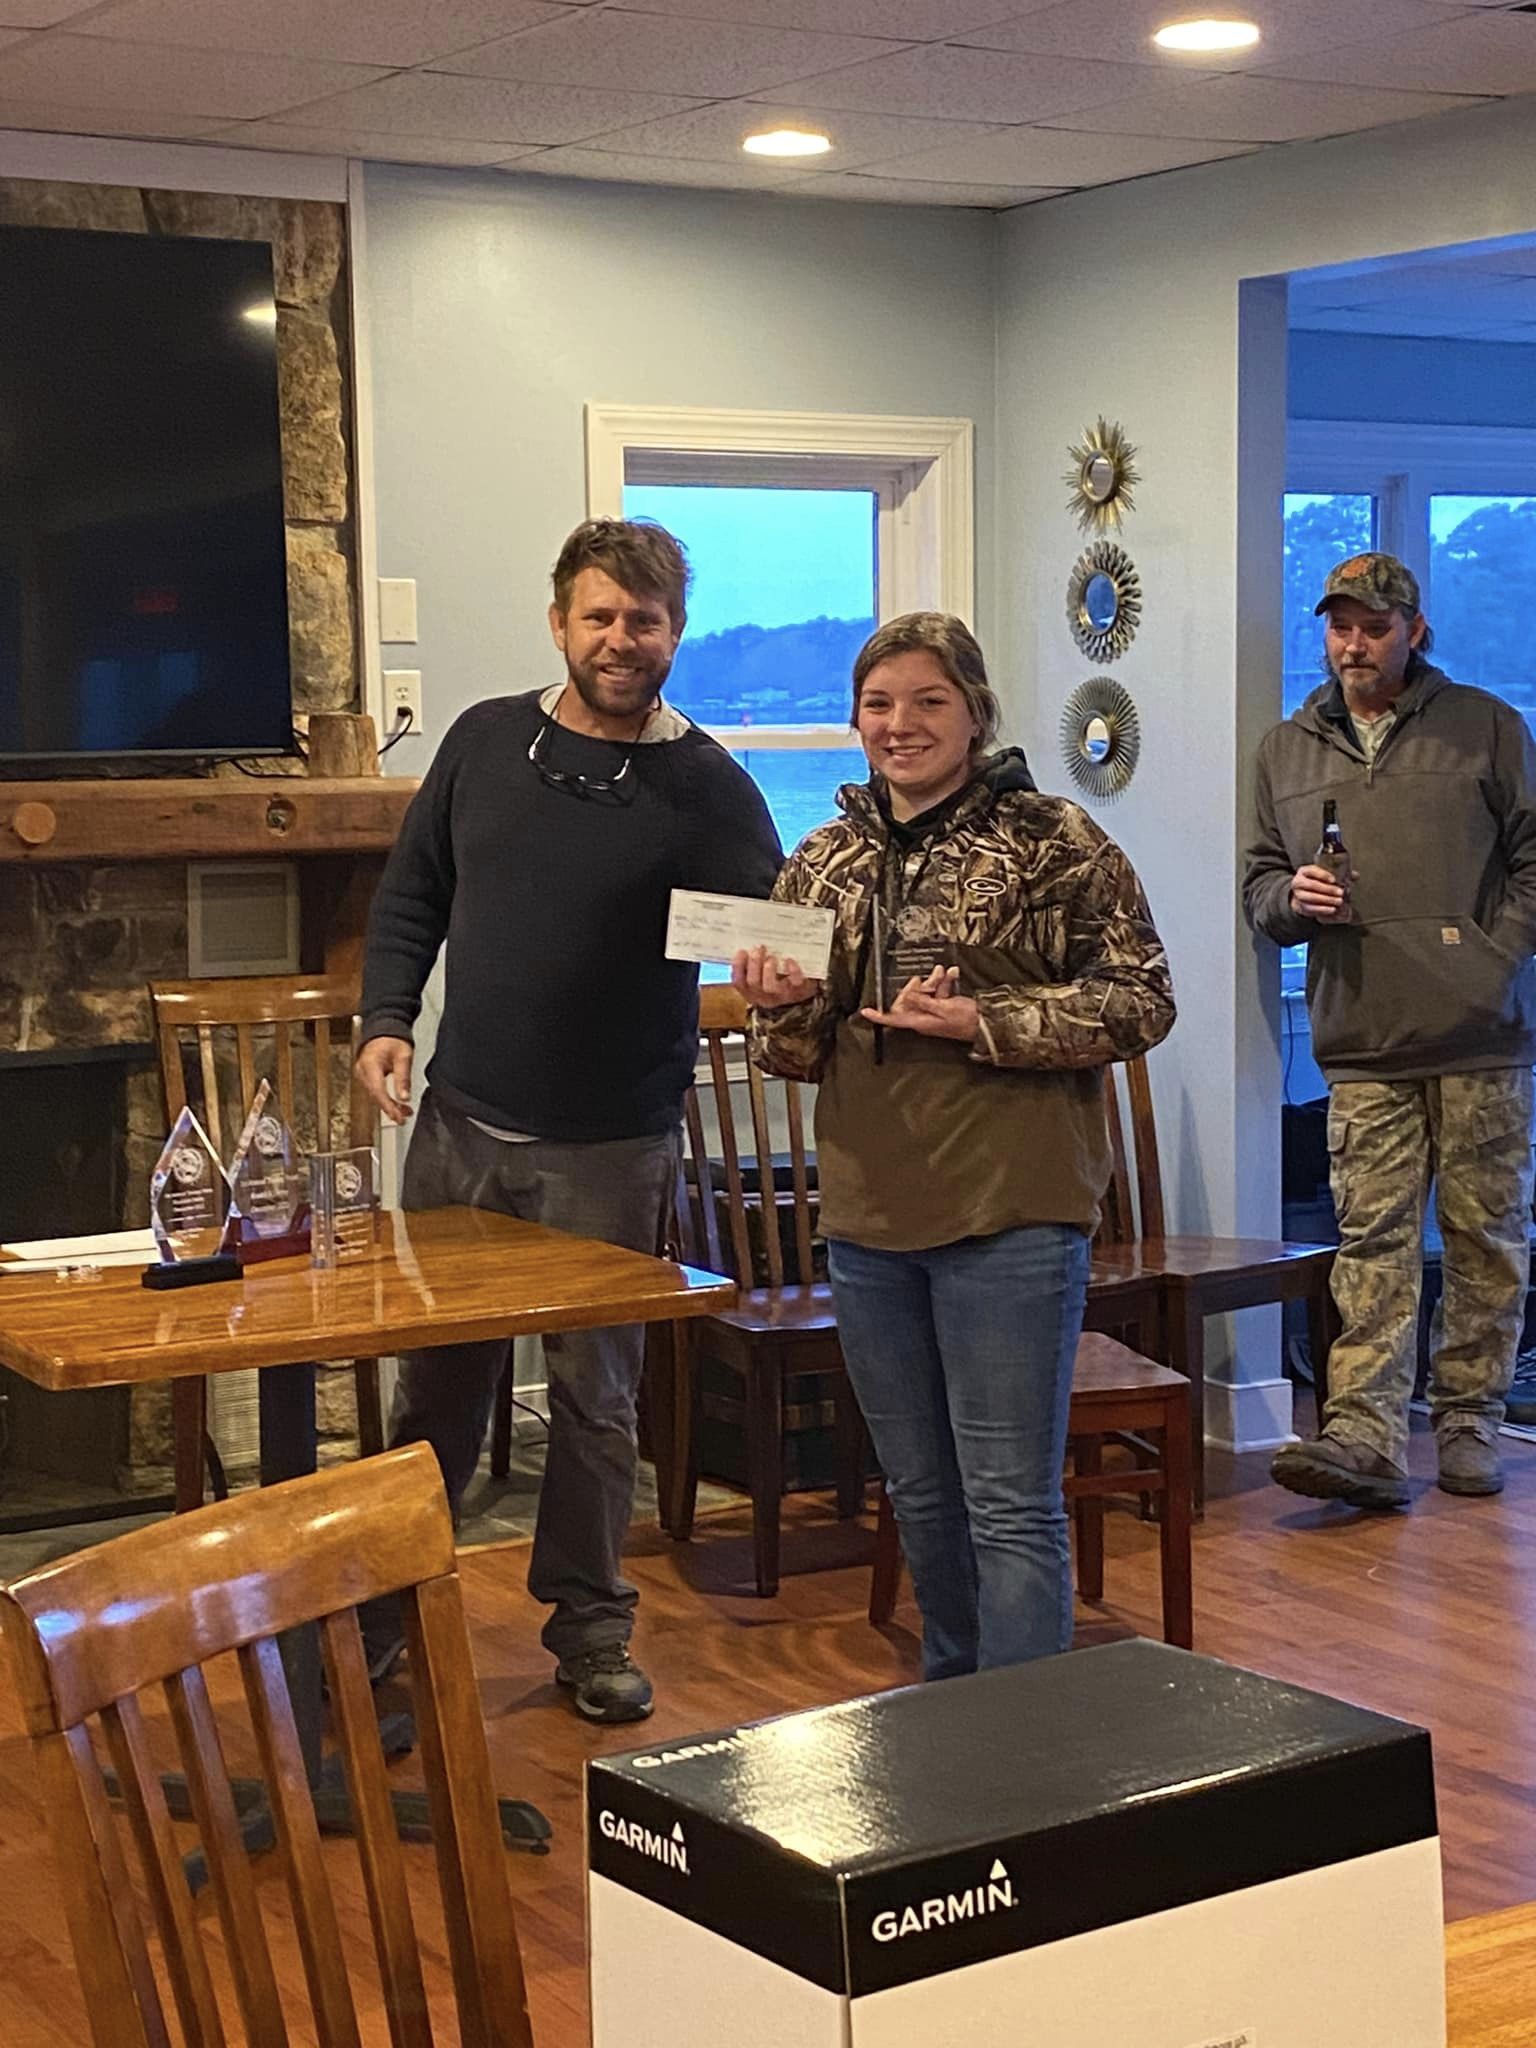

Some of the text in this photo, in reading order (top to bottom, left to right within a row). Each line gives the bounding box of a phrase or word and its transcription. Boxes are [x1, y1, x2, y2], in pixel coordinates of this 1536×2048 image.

[632, 1736, 752, 1768] GARMI
[599, 1809, 688, 1873] GARMIN
[871, 1878, 1013, 1942] GARMIN
